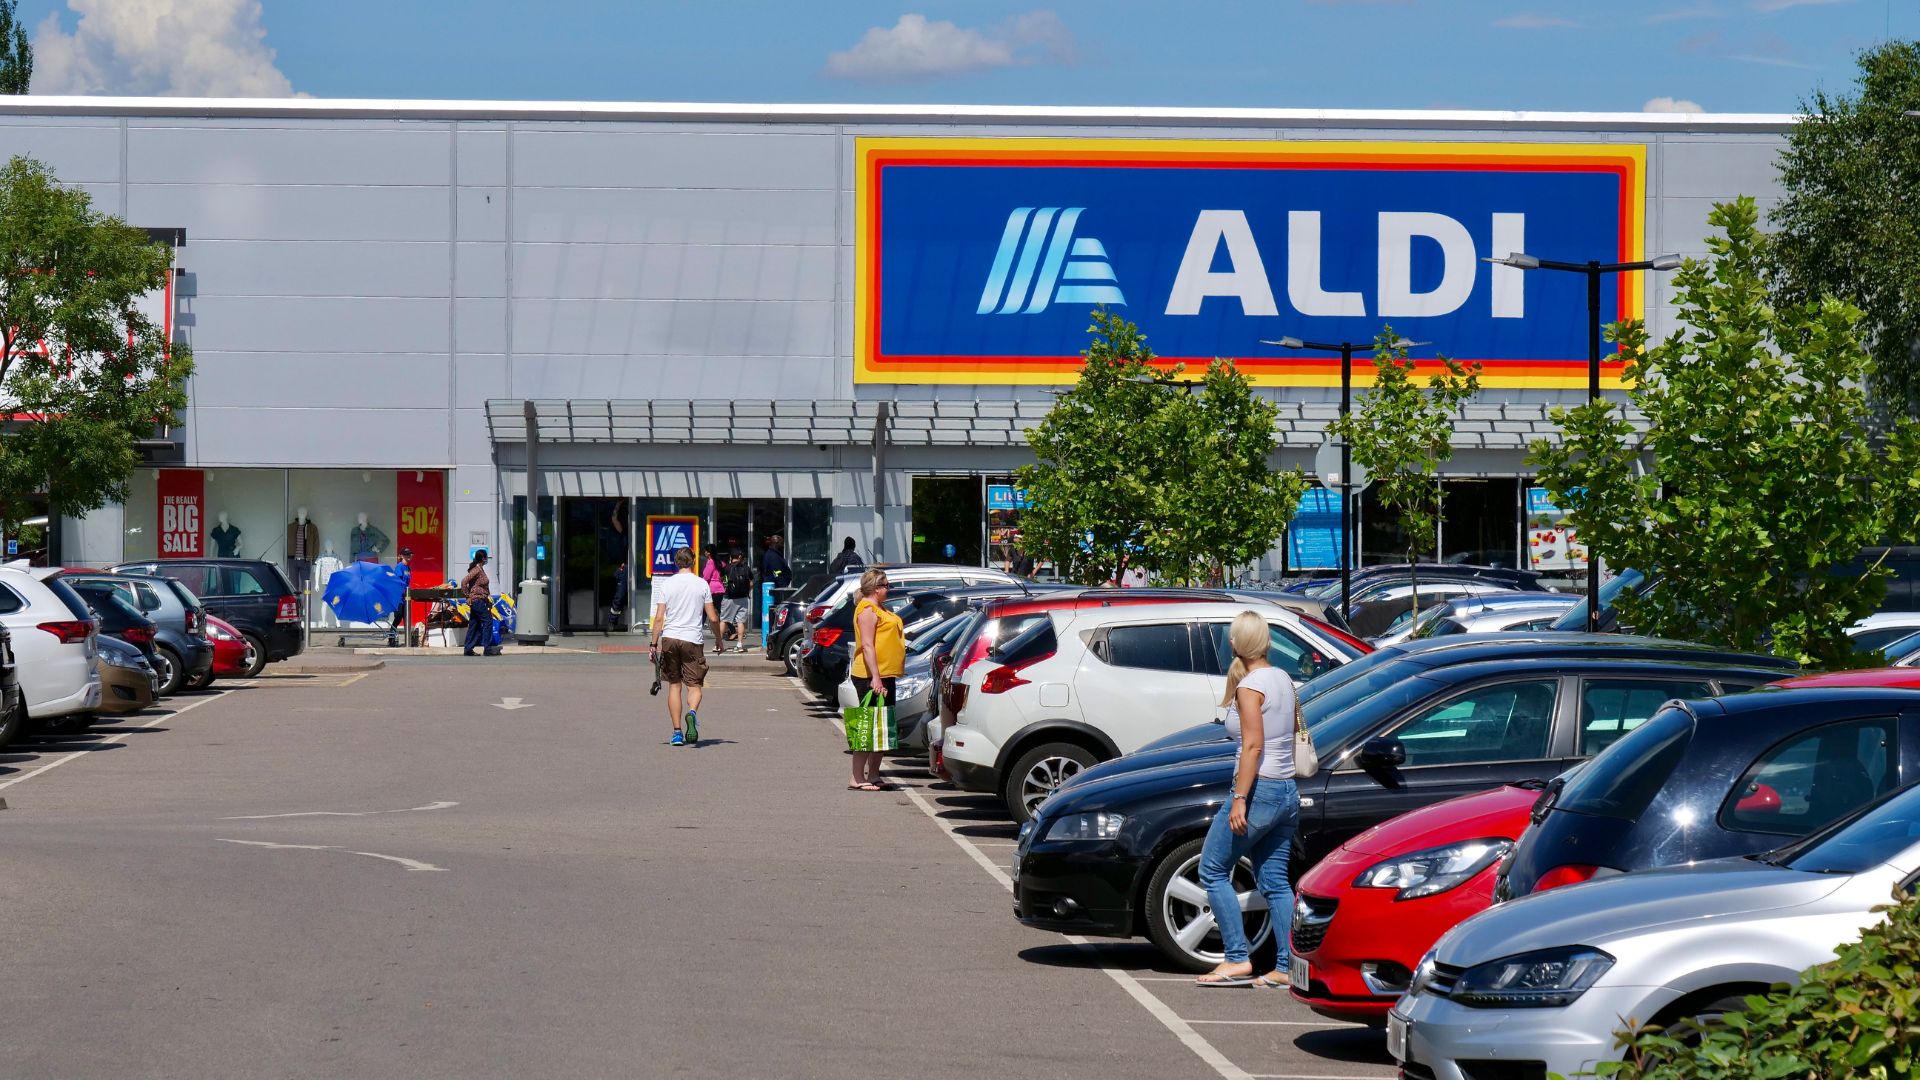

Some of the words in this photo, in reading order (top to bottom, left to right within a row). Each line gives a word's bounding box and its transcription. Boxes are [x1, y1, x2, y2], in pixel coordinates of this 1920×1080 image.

[1164, 209, 1525, 318] ALDI
[163, 496, 174, 504] THE
[176, 496, 198, 504] REALLY
[163, 505, 198, 532] BIG
[401, 506, 438, 534] 50%
[163, 533, 198, 552] SALE
[655, 553, 675, 565] AL
